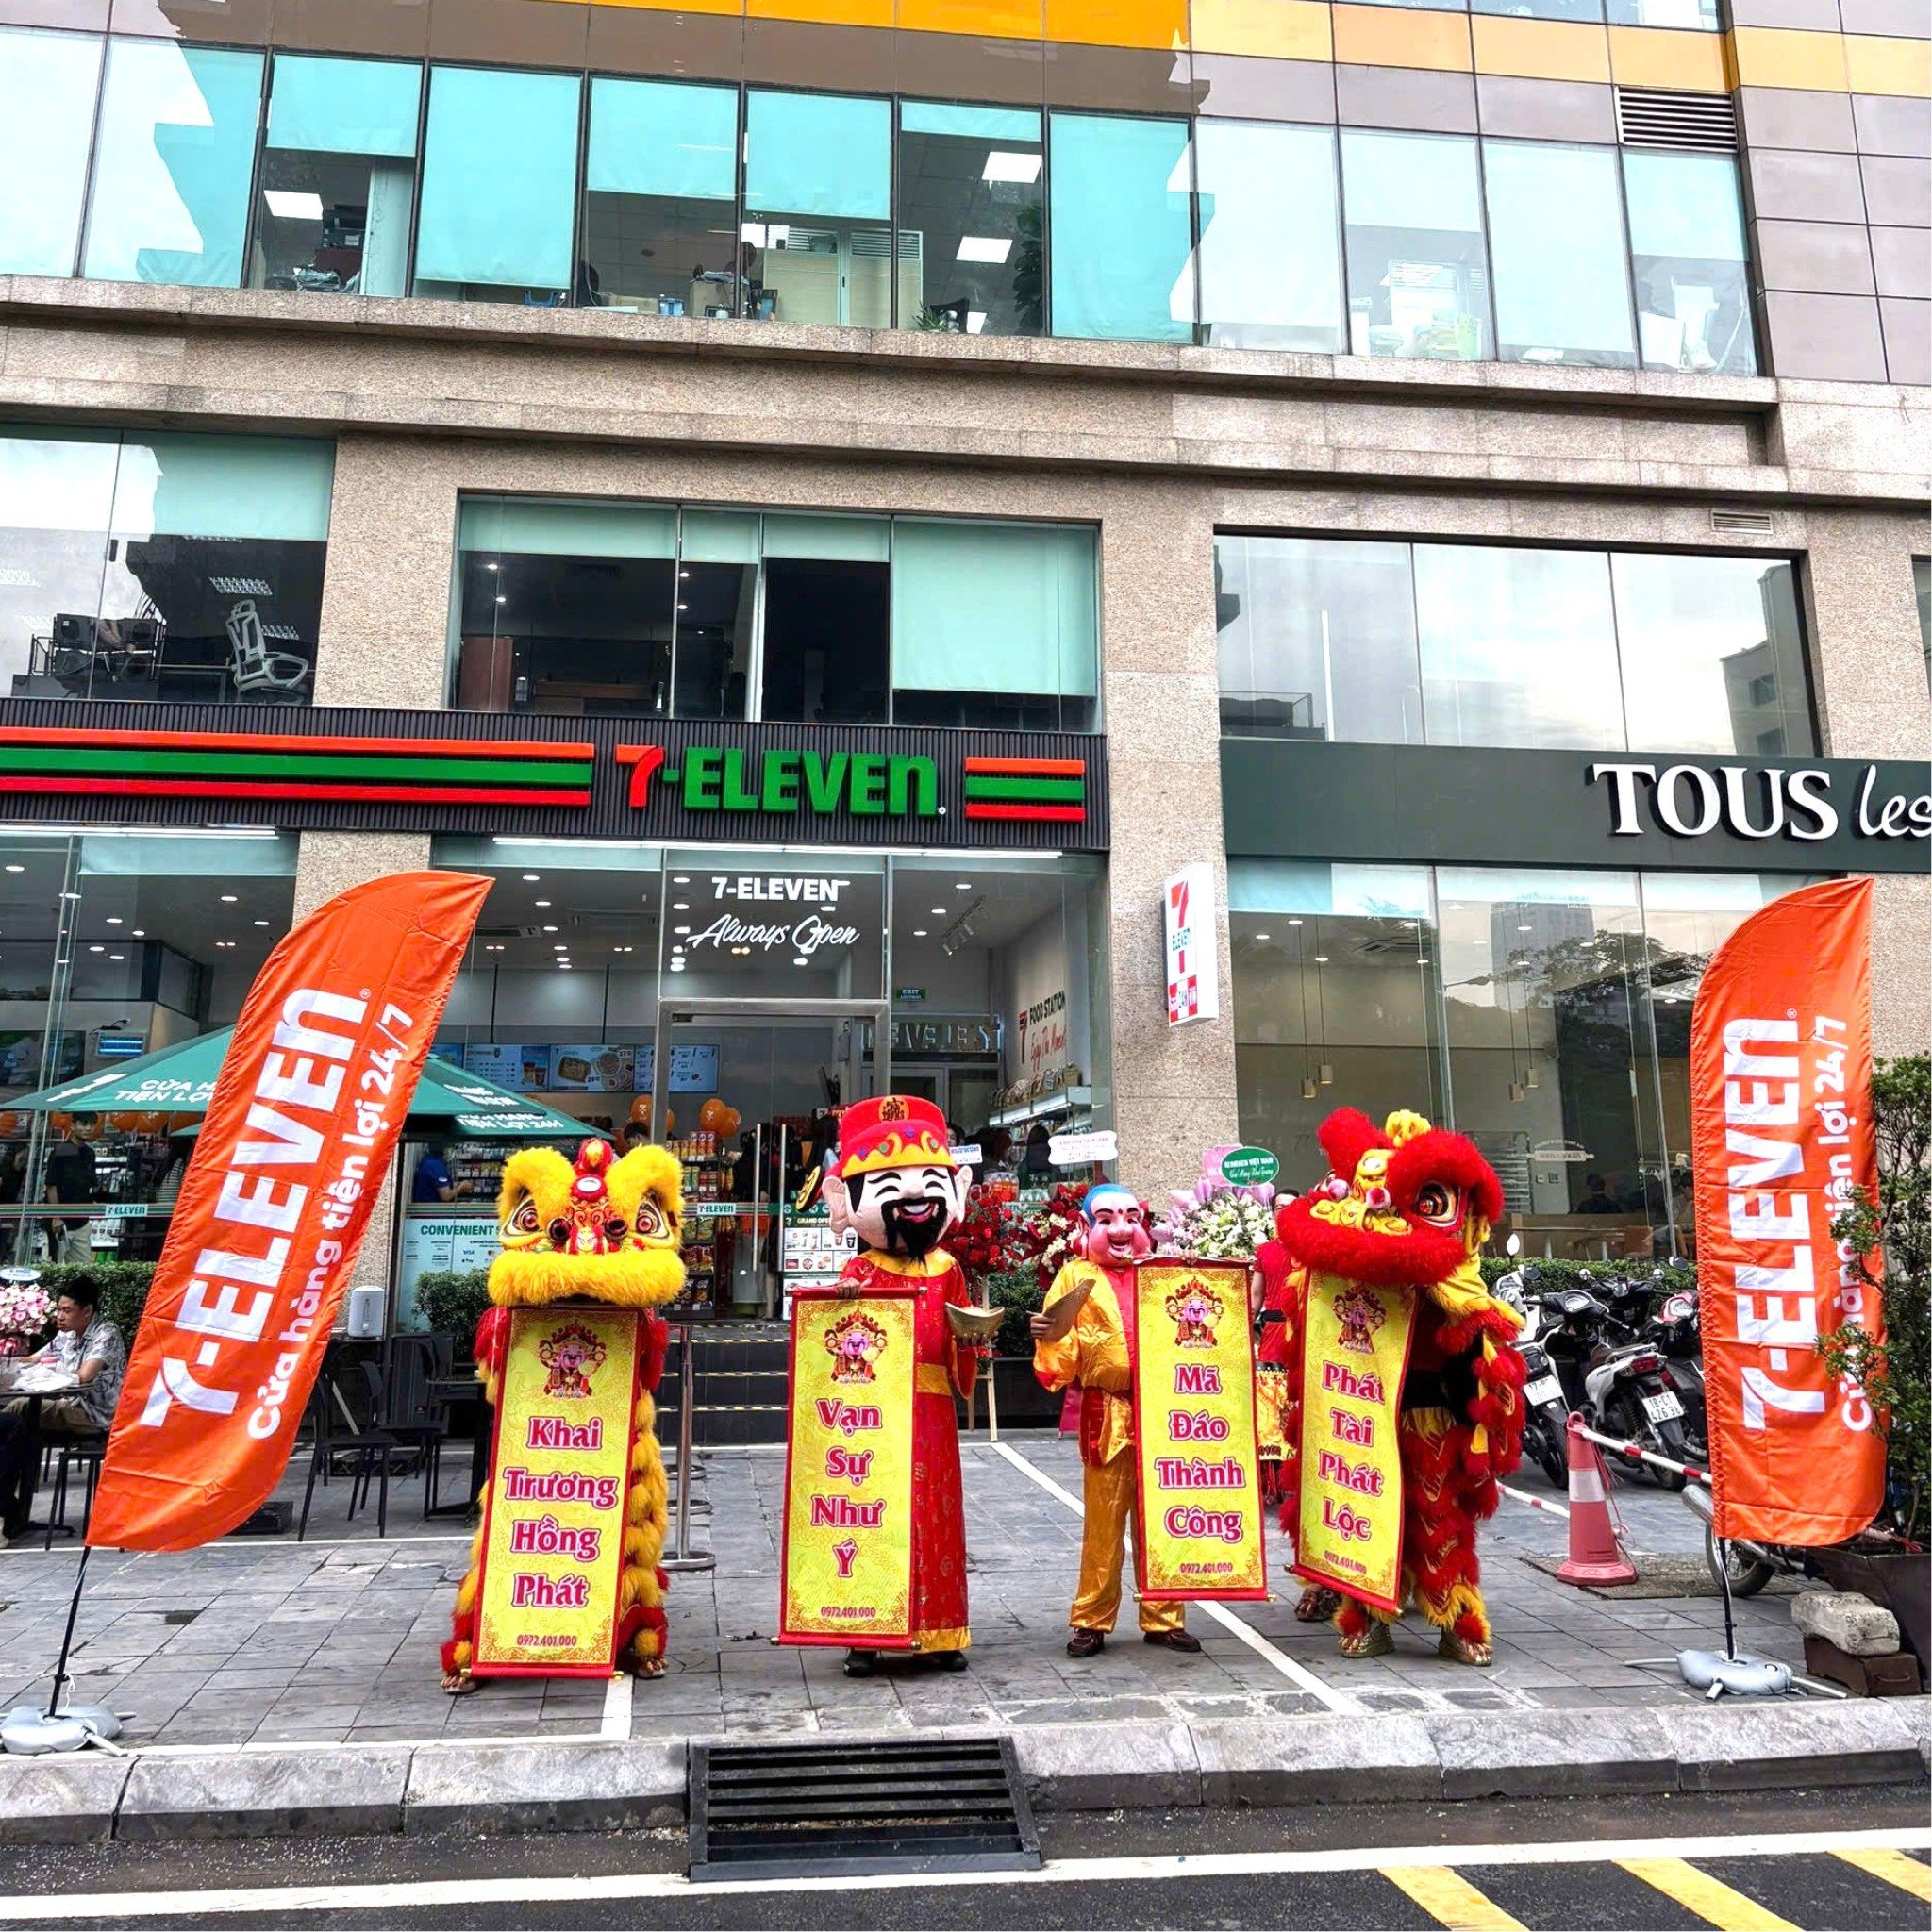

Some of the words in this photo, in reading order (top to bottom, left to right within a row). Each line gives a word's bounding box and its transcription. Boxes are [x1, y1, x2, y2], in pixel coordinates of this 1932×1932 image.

[1592, 762, 1840, 840] TOUS
[711, 876, 839, 902] 7-ELEVEN
[685, 913, 791, 951] Always
[791, 914, 860, 954] Open
[361, 1003, 414, 1091] 24/7
[1812, 1015, 1850, 1094] 24/7
[350, 1072, 390, 1146] lợi
[317, 1128, 373, 1231] tiện
[421, 1225, 494, 1235] CONVENIENT
[277, 1242, 343, 1345] hàng
[247, 1355, 303, 1441] Cửa
[1174, 1363, 1223, 1394] Mã
[528, 1416, 604, 1450] Khai
[815, 1398, 883, 1437] Vạn
[1169, 1409, 1230, 1441] Đáo
[1330, 1407, 1374, 1448] Tài
[825, 1445, 874, 1486] Sự
[1154, 1457, 1247, 1489] Thành
[1319, 1449, 1384, 1497] Phát
[504, 1466, 619, 1509] Trương
[811, 1494, 887, 1527] Như
[1165, 1506, 1243, 1543] Công
[1323, 1497, 1371, 1541] Lộc
[511, 1515, 601, 1562] Hồng
[832, 1538, 859, 1578] Ý
[1179, 1563, 1233, 1574] 0972.401.000
[512, 1572, 591, 1608] Phát
[820, 1606, 876, 1618] 0972.401.000
[516, 1634, 577, 1646] 0972.401.000
